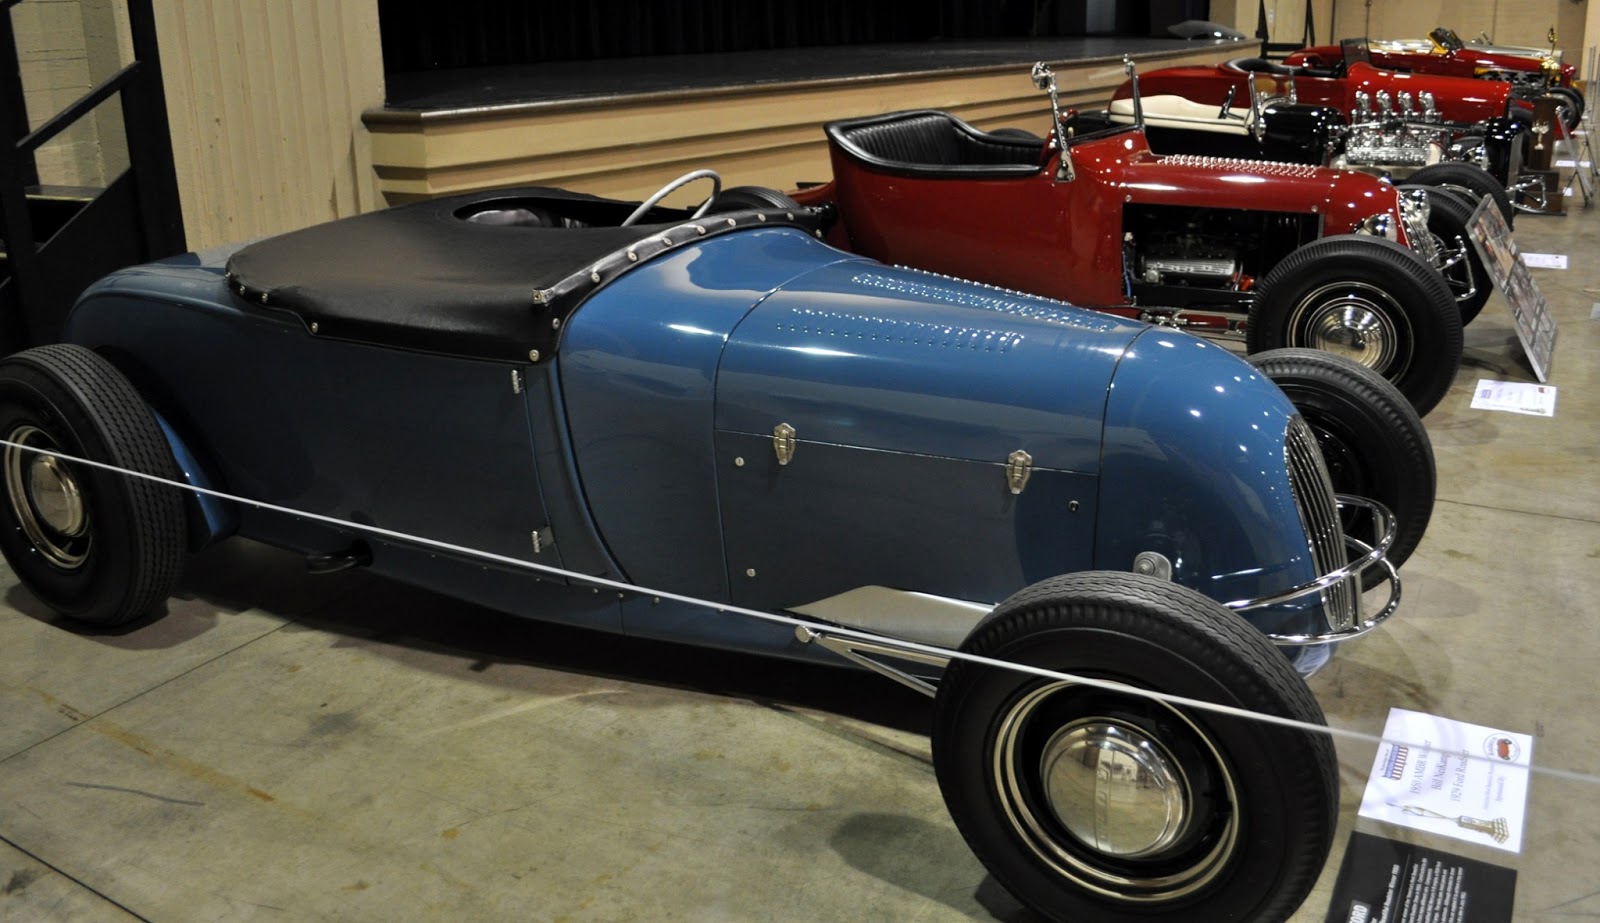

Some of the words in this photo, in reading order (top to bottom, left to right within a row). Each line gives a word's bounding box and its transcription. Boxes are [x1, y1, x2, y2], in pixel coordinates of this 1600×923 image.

[1417, 738, 1431, 759] Wier
[1455, 748, 1469, 773] Roadser
[1412, 758, 1426, 780] AMBR
[1408, 778, 1422, 794] 1950
[1431, 778, 1443, 790] Bill
[1452, 772, 1464, 787] Ford
[1449, 786, 1462, 802] 1929
